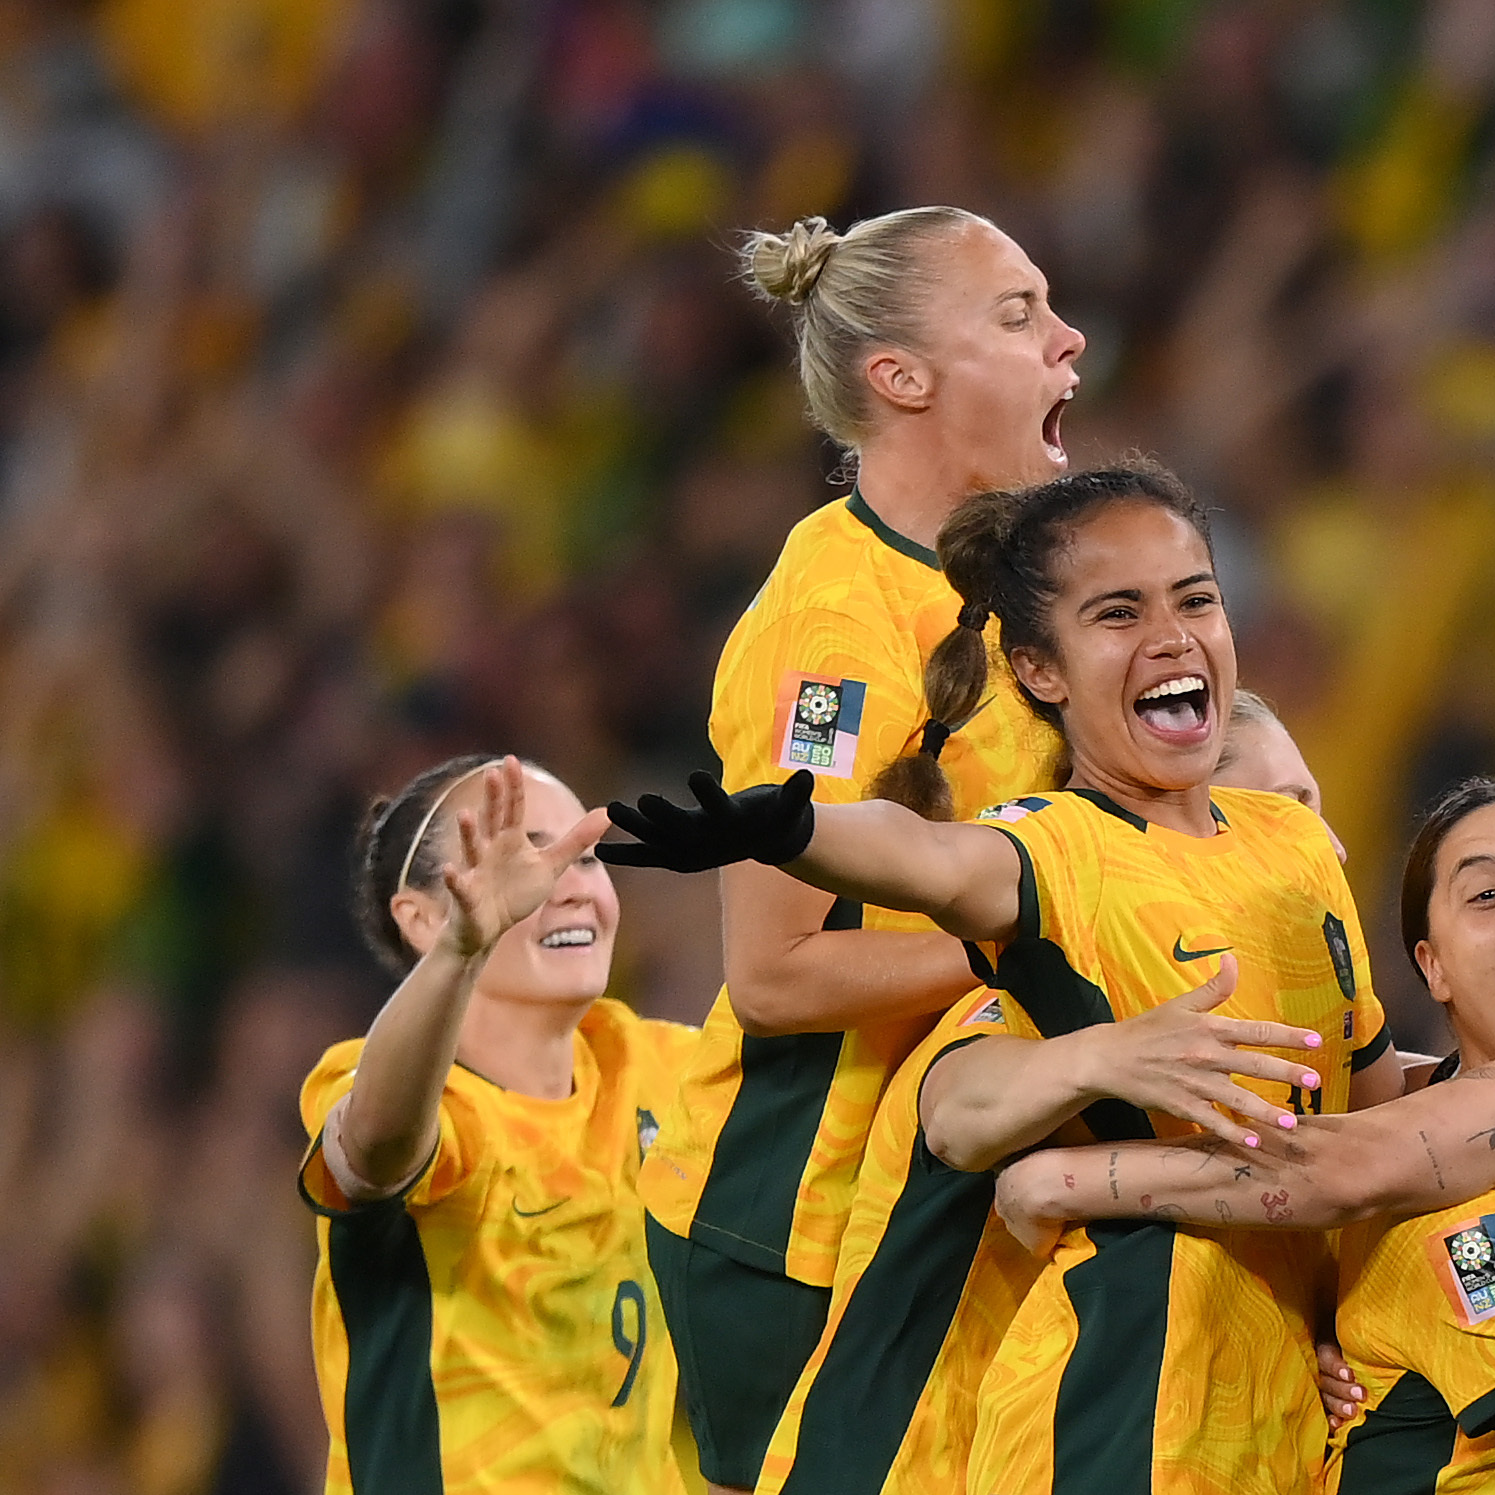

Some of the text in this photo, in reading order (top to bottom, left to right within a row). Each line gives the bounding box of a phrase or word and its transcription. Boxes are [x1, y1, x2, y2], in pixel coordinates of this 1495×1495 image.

[792, 742, 810, 752] AU
[791, 752, 809, 762] NZ
[1470, 1289, 1488, 1303] AU
[1474, 1298, 1492, 1312] NZ
[611, 1279, 647, 1408] 9
